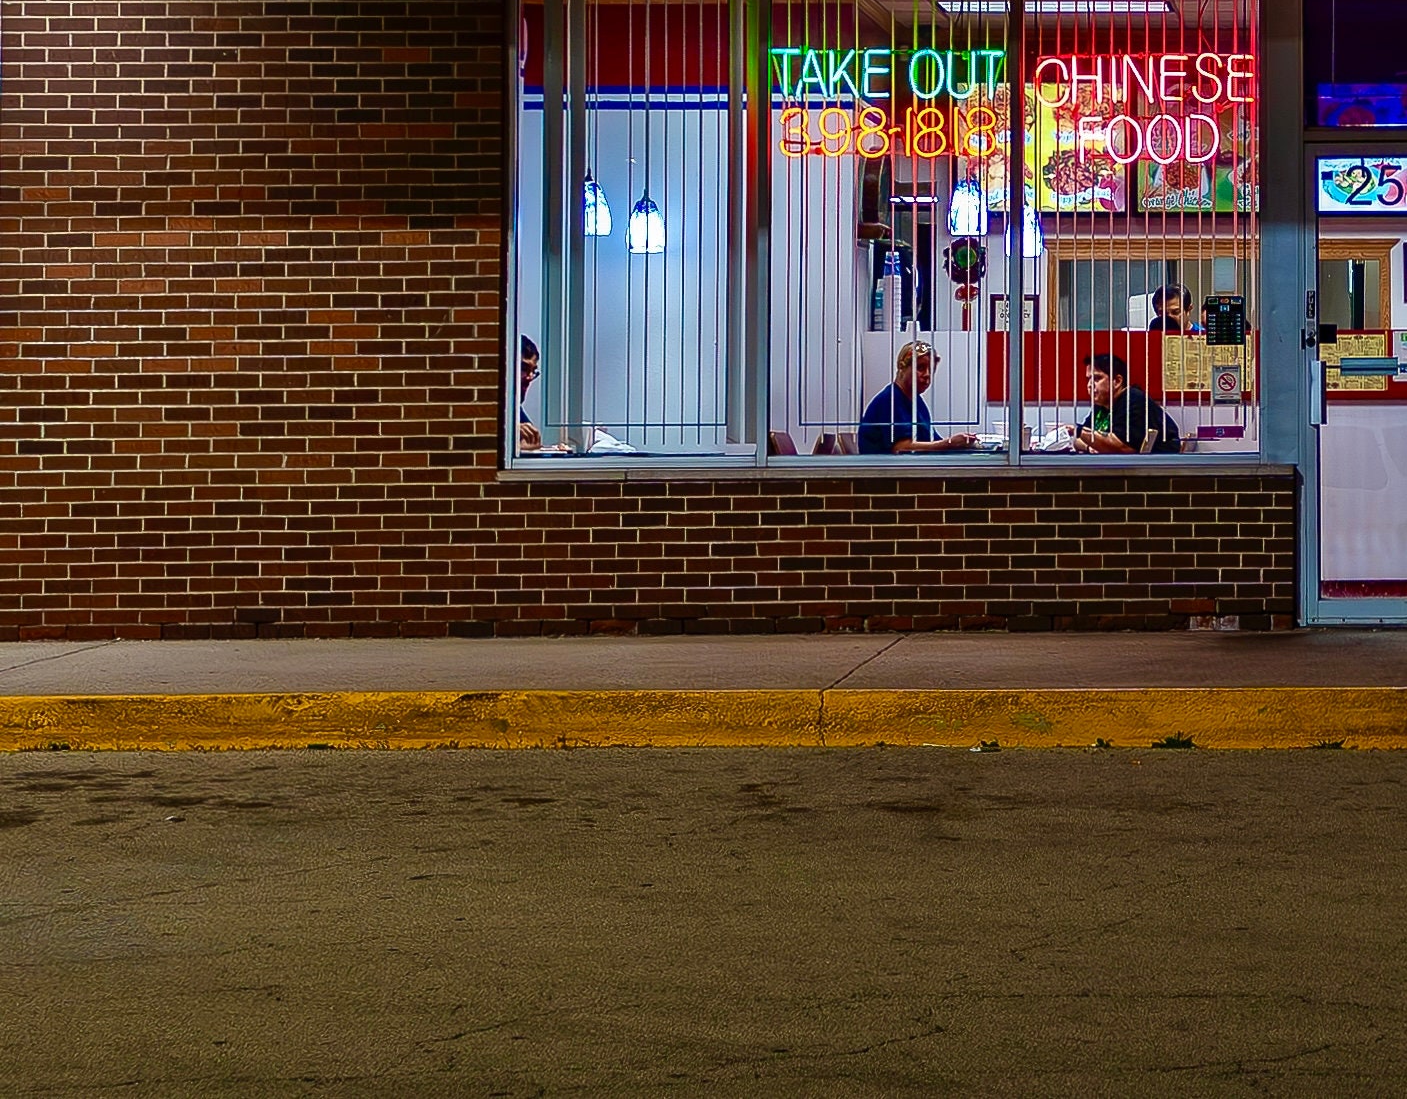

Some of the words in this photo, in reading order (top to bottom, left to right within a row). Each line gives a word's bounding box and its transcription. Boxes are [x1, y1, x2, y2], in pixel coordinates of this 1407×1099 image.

[770, 48, 890, 99] TAKE
[909, 48, 1005, 100] OUT
[1035, 52, 1255, 109] CHINESE
[779, 106, 997, 159] 398-1818
[1078, 114, 1220, 165] FOOD
